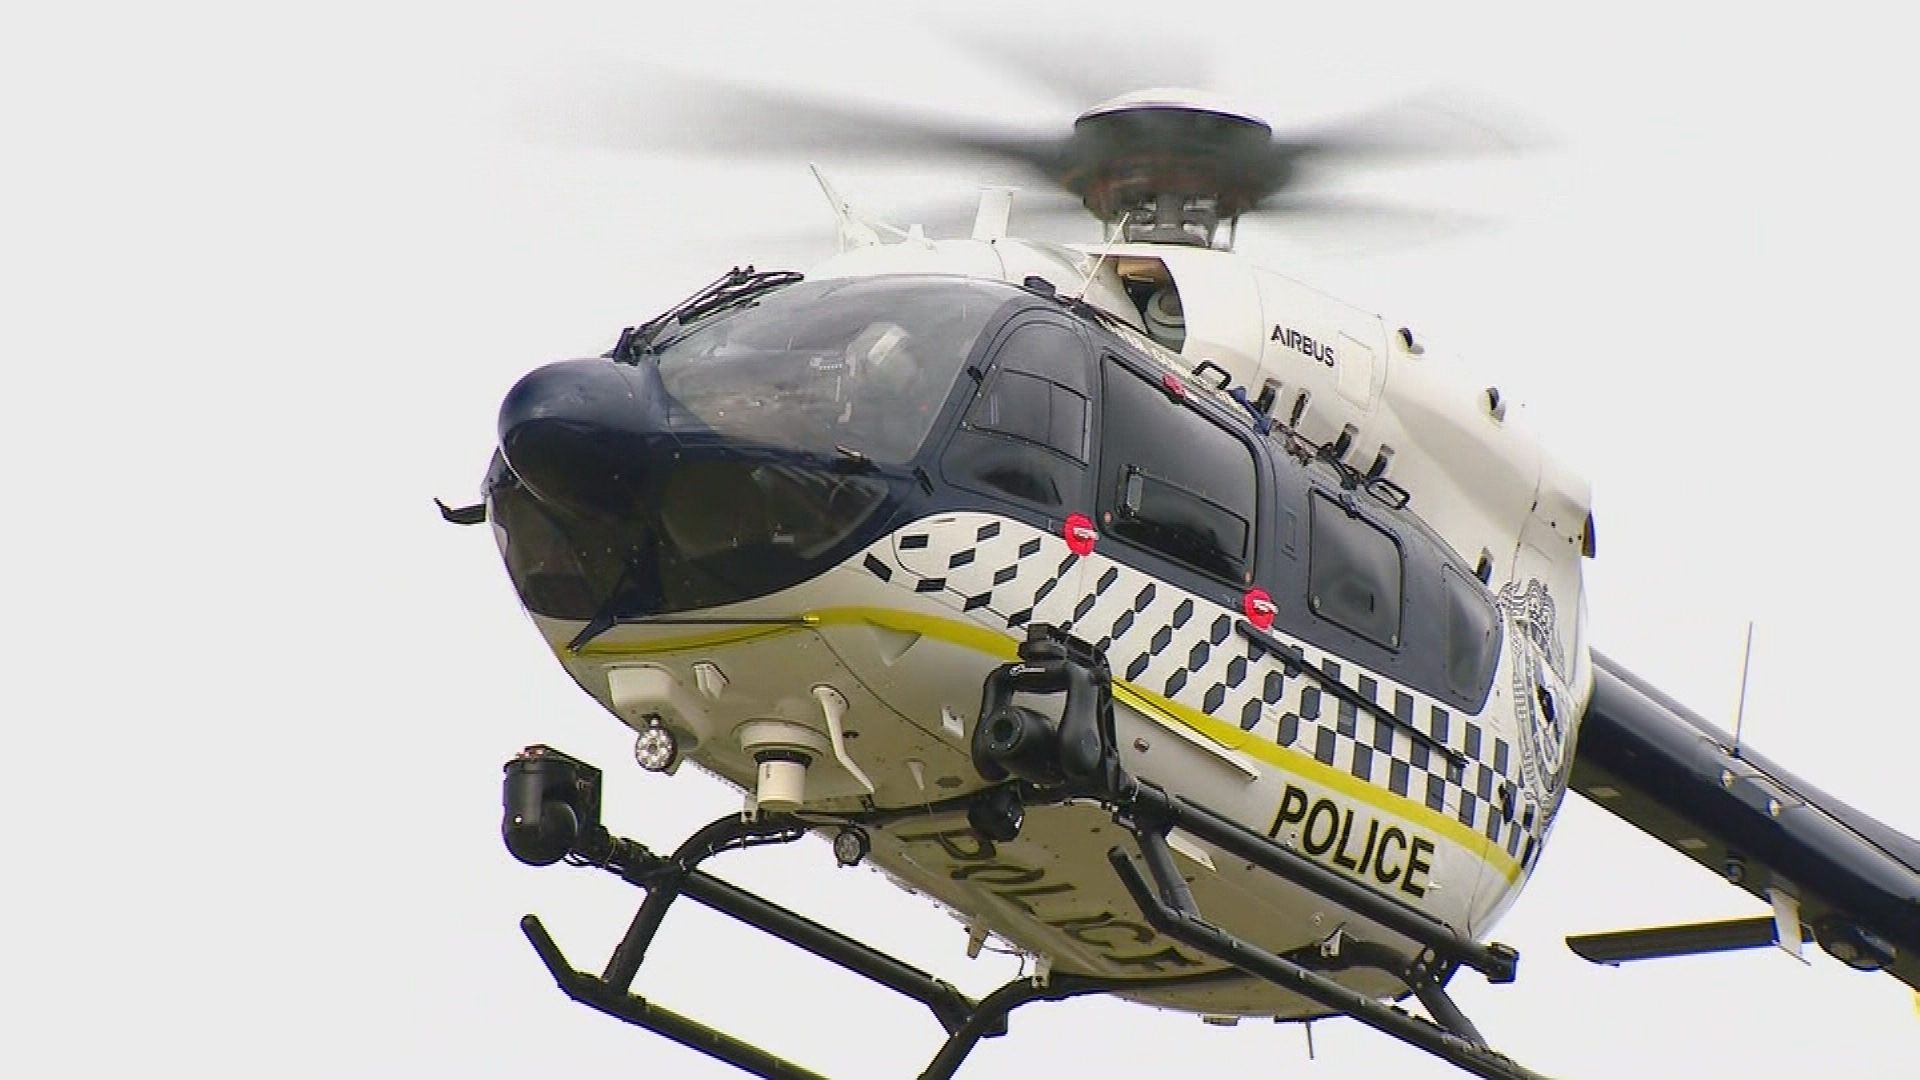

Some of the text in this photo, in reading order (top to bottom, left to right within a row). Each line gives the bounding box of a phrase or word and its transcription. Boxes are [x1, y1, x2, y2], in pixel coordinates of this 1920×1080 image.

[1271, 324, 1334, 368] AIRBUS
[1268, 783, 1435, 898] POLICE
[897, 828, 1203, 971] POLICE
